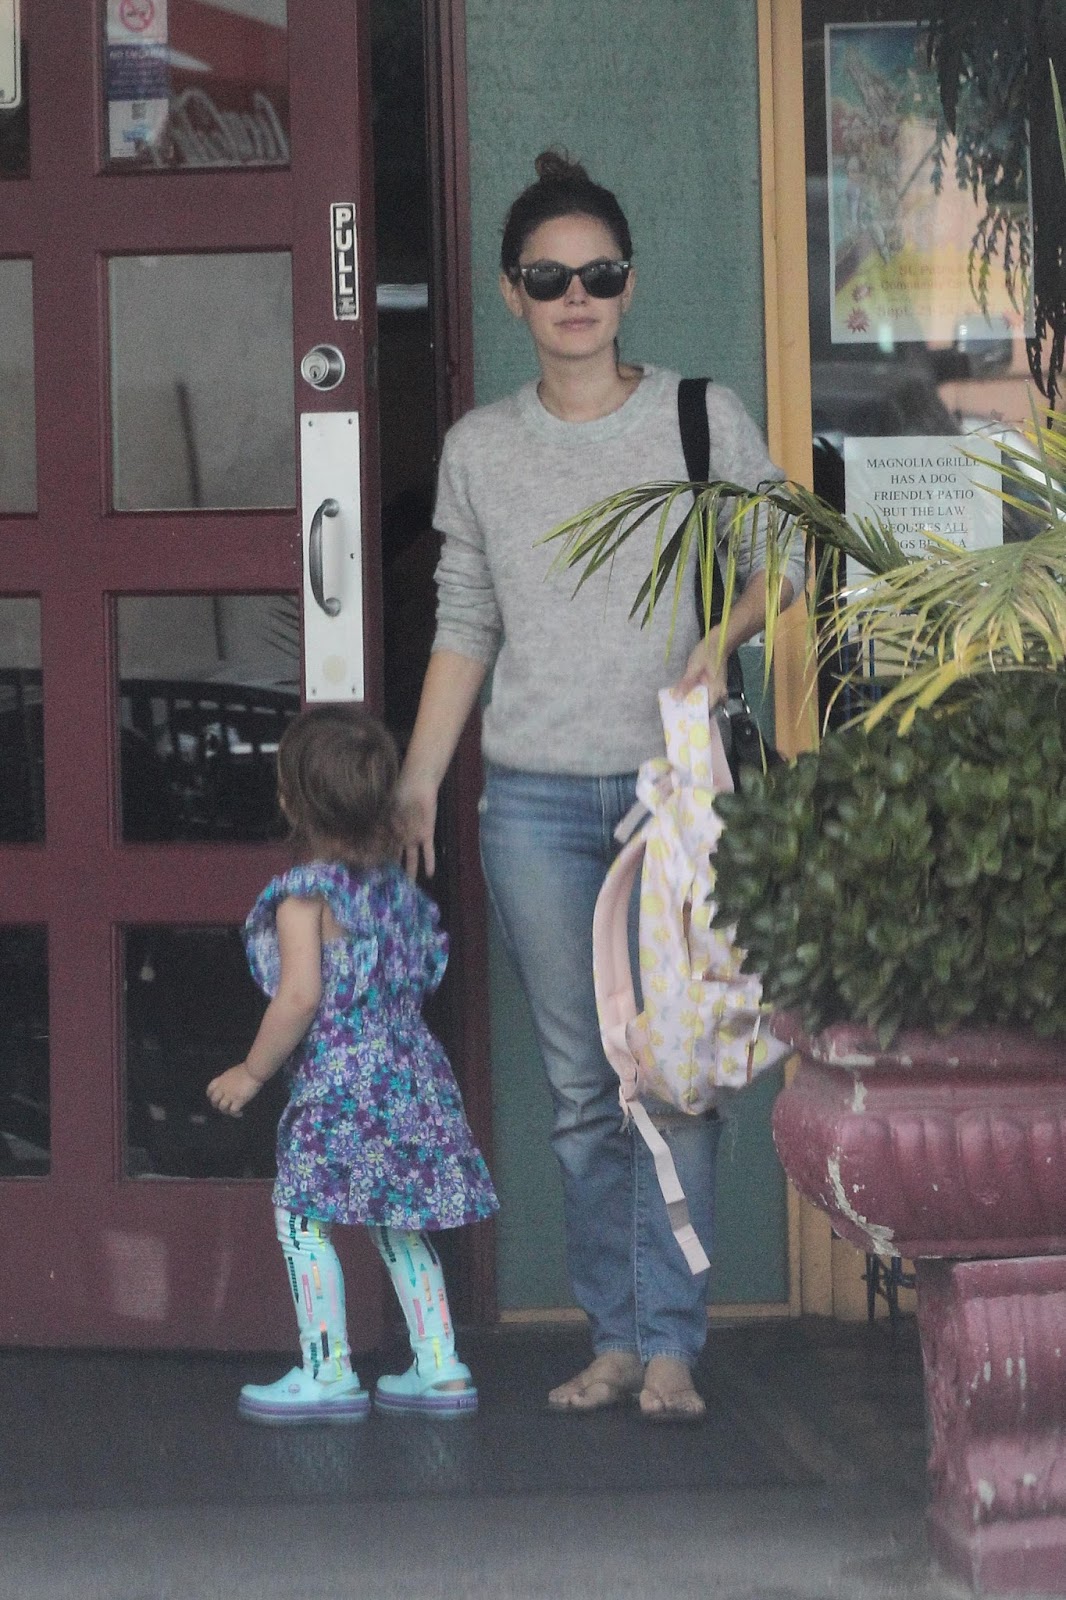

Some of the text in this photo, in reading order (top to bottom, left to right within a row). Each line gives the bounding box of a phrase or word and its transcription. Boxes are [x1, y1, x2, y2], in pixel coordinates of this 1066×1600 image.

[335, 207, 353, 295] PULL
[866, 457, 933, 469] MAGNOLIA
[891, 473, 957, 485] HAS A DOG
[874, 489, 974, 501] FRIENDLY PATIO
[883, 506, 966, 517] BUT THE LAW
[945, 522, 968, 534] ALL
